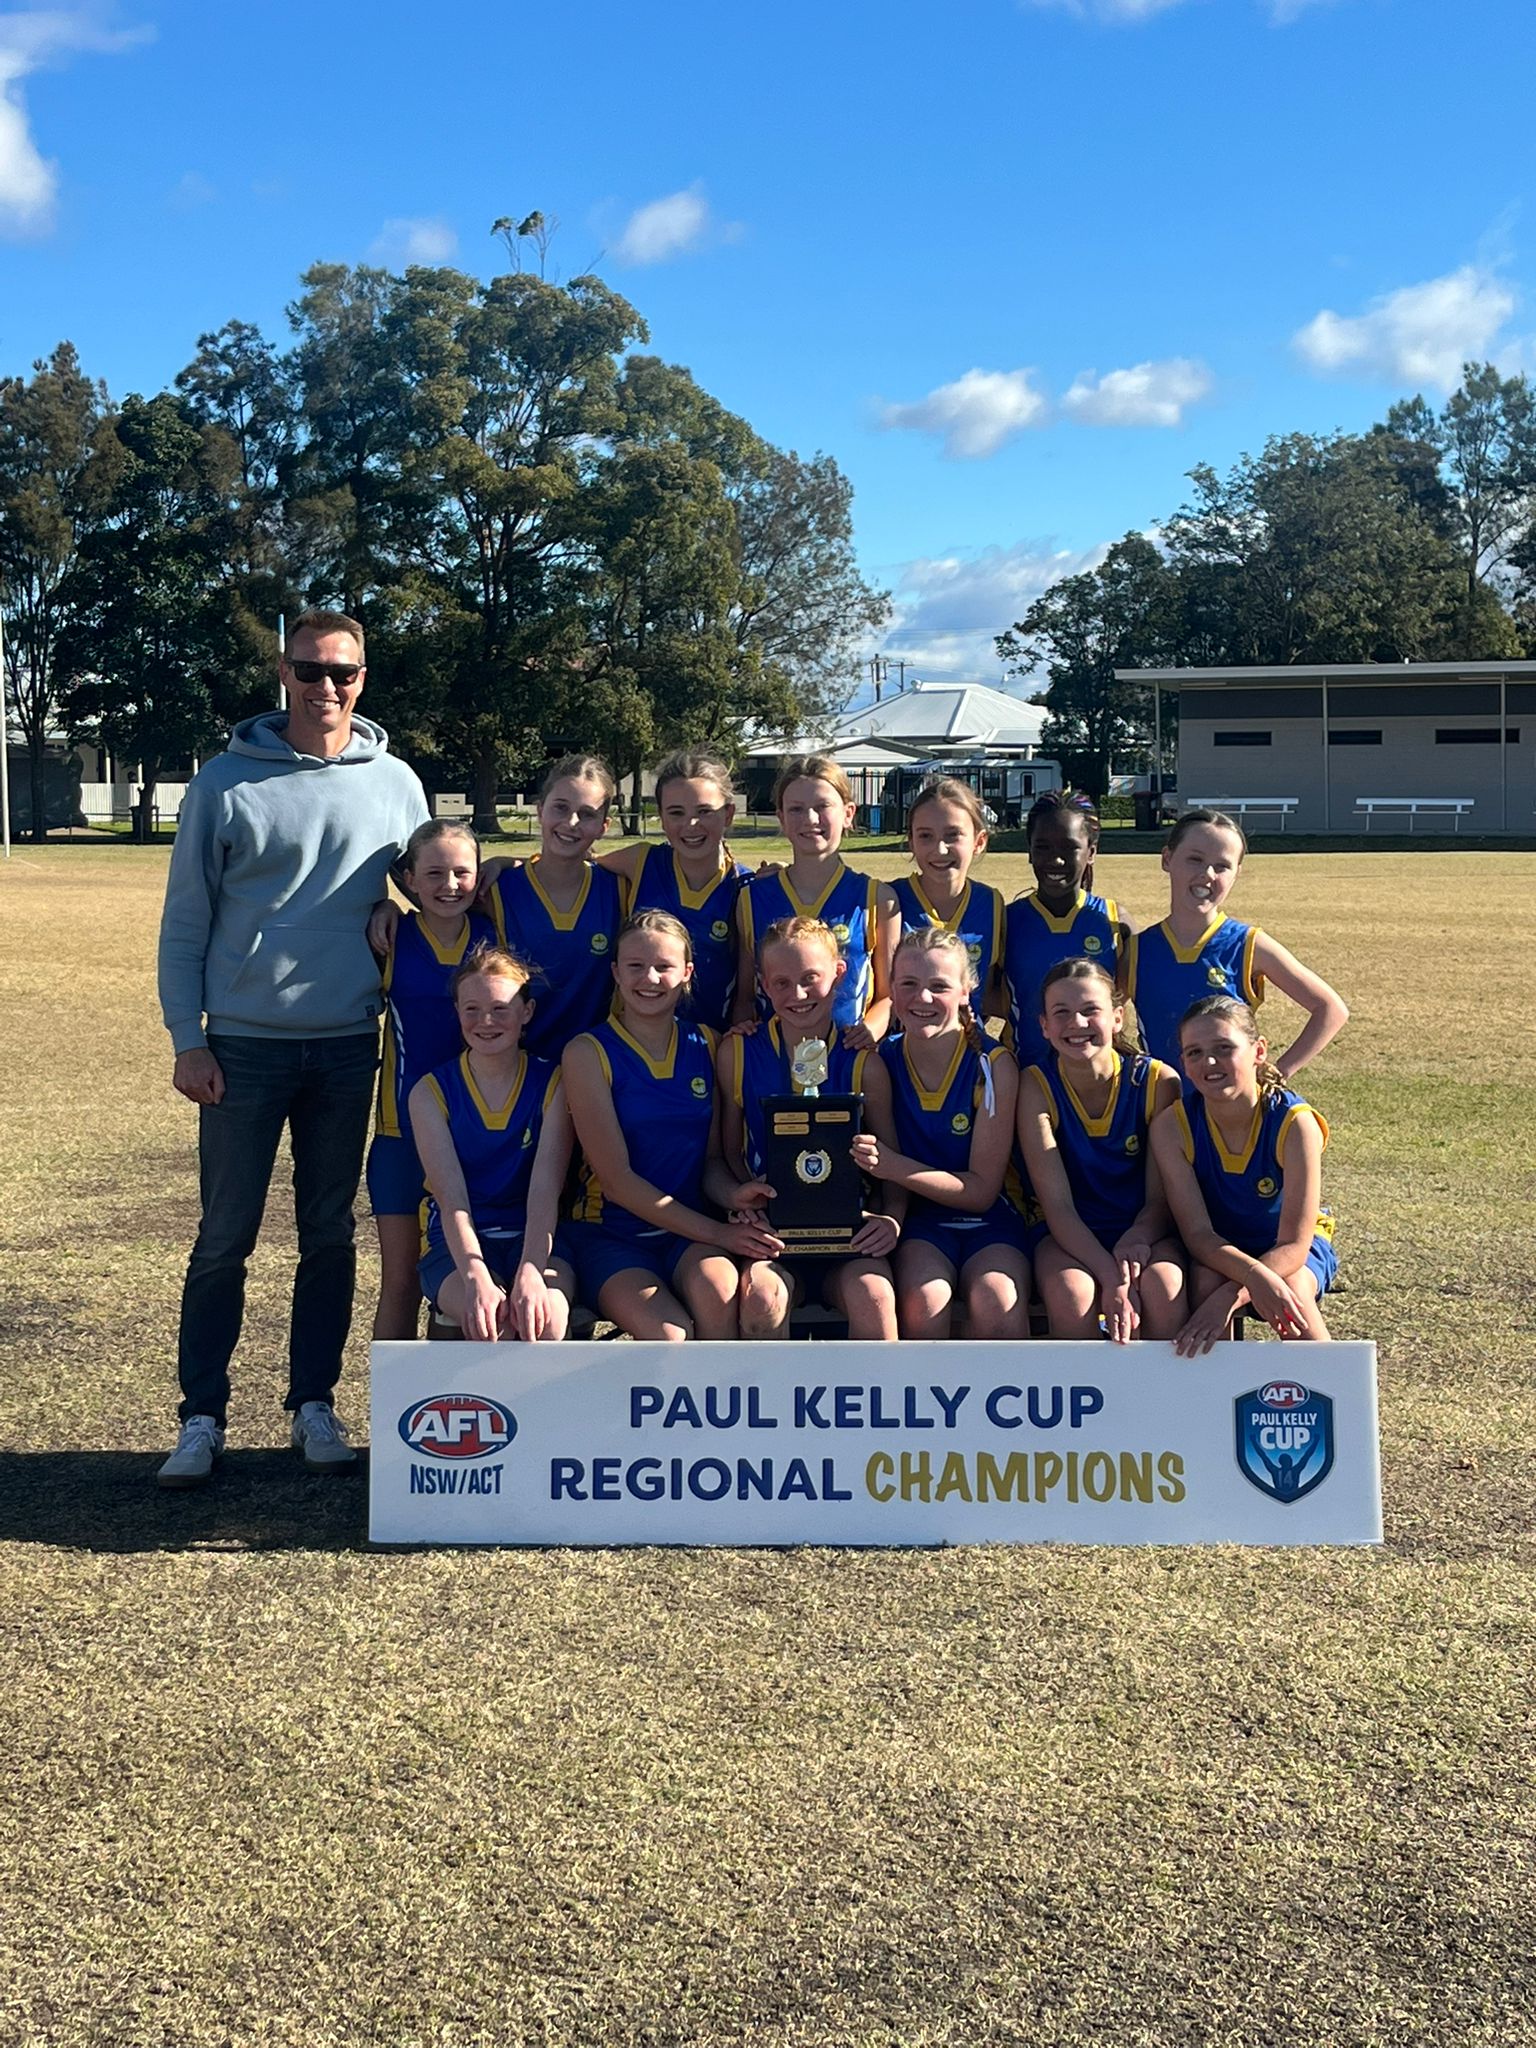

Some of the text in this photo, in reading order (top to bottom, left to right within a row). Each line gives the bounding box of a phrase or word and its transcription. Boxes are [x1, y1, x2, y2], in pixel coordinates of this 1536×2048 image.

[631, 1385, 1104, 1429] PAUL KELLY CUP
[1263, 1387, 1305, 1401] AFL
[407, 1409, 509, 1442] AFL
[1251, 1412, 1318, 1426] PAUL KELLY
[1260, 1427, 1311, 1450] CUP
[410, 1463, 504, 1494] NSW/ACT
[550, 1453, 1187, 1504] REGIONAL CHAMPIONS
